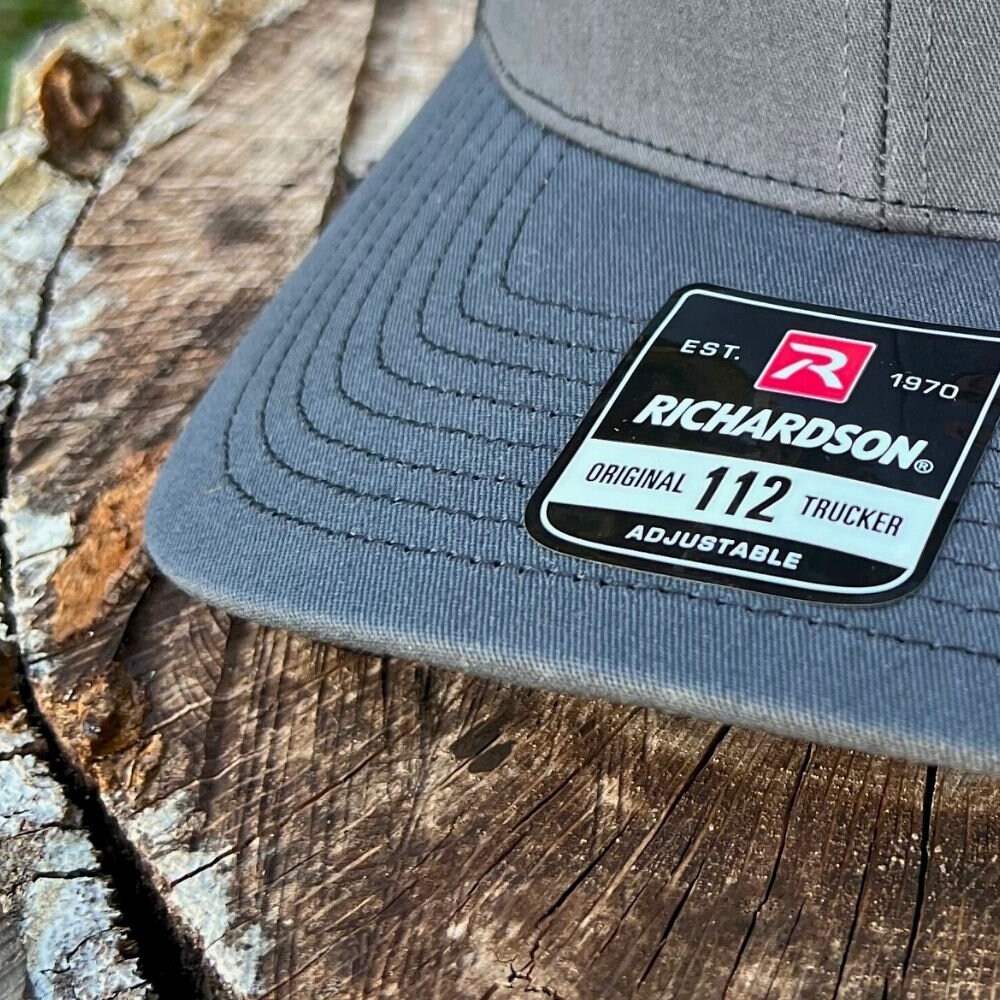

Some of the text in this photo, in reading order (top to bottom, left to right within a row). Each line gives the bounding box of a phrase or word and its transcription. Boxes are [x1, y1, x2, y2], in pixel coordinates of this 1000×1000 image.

[680, 339, 741, 361] EST.
[889, 373, 960, 400] 1970
[585, 463, 903, 537] ORIGINAL 112 TRUCKER
[625, 524, 803, 570] ADJUSTABLE
